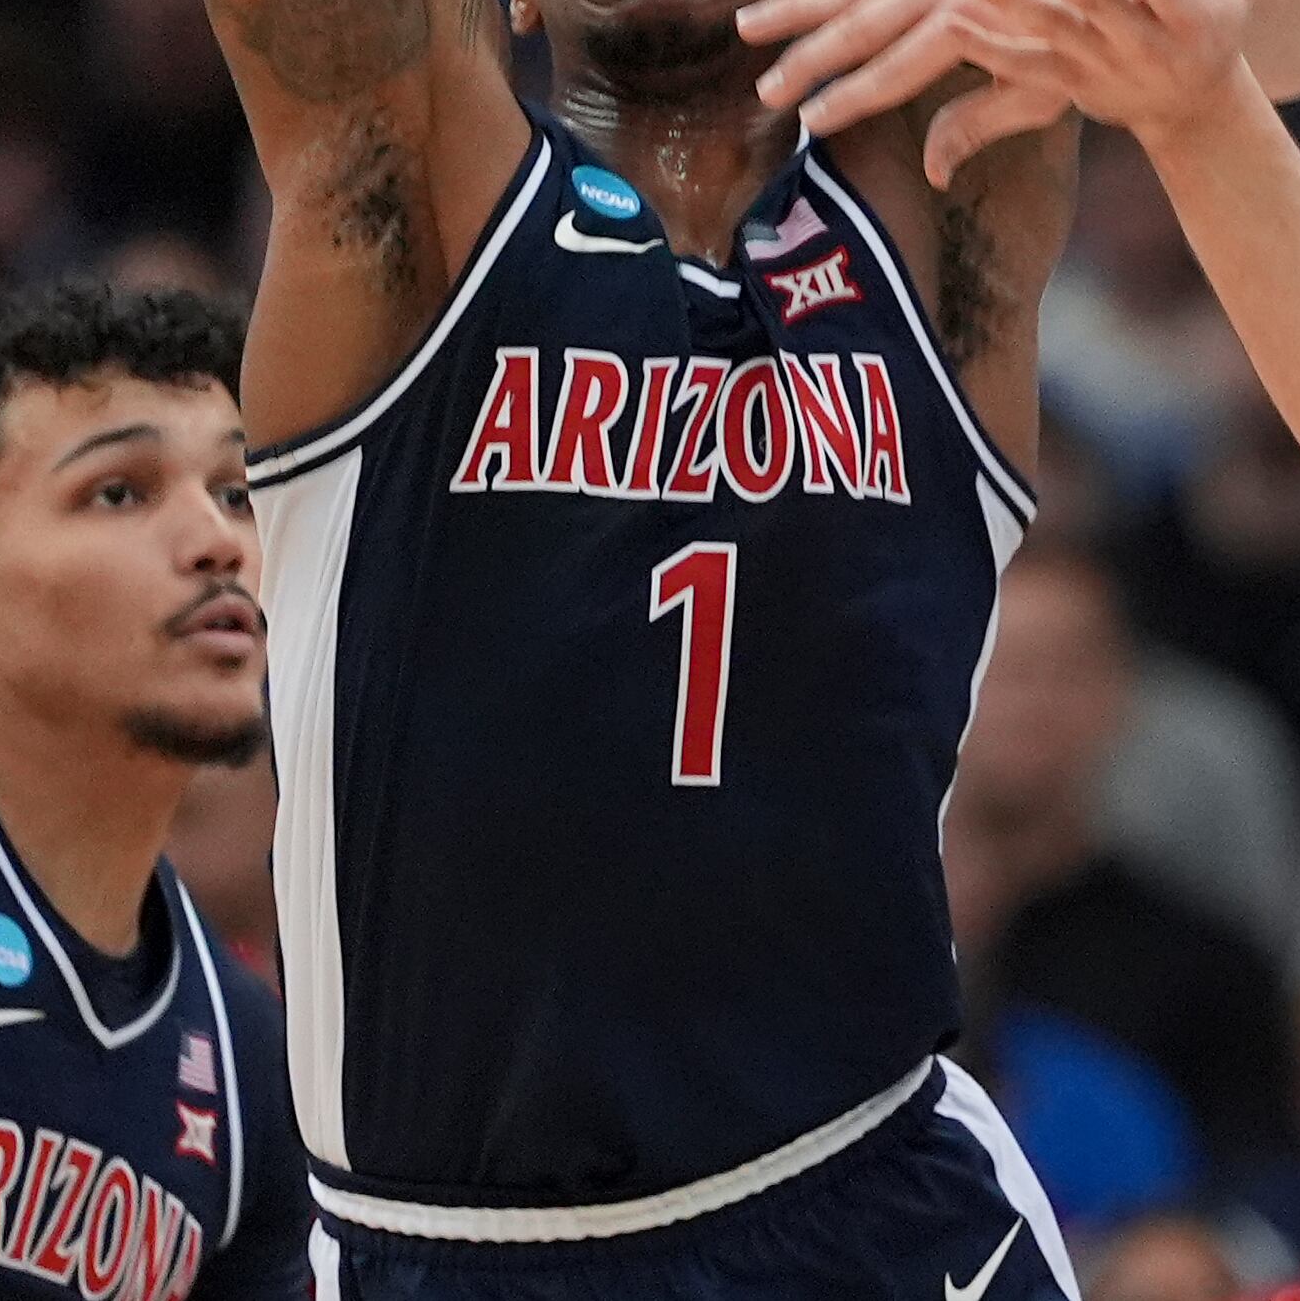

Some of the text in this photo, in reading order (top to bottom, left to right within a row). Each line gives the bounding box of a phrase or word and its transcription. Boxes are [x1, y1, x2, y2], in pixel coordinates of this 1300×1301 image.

[767, 248, 859, 322] XII
[450, 346, 911, 505] ARIZONA
[649, 540, 737, 787] 1
